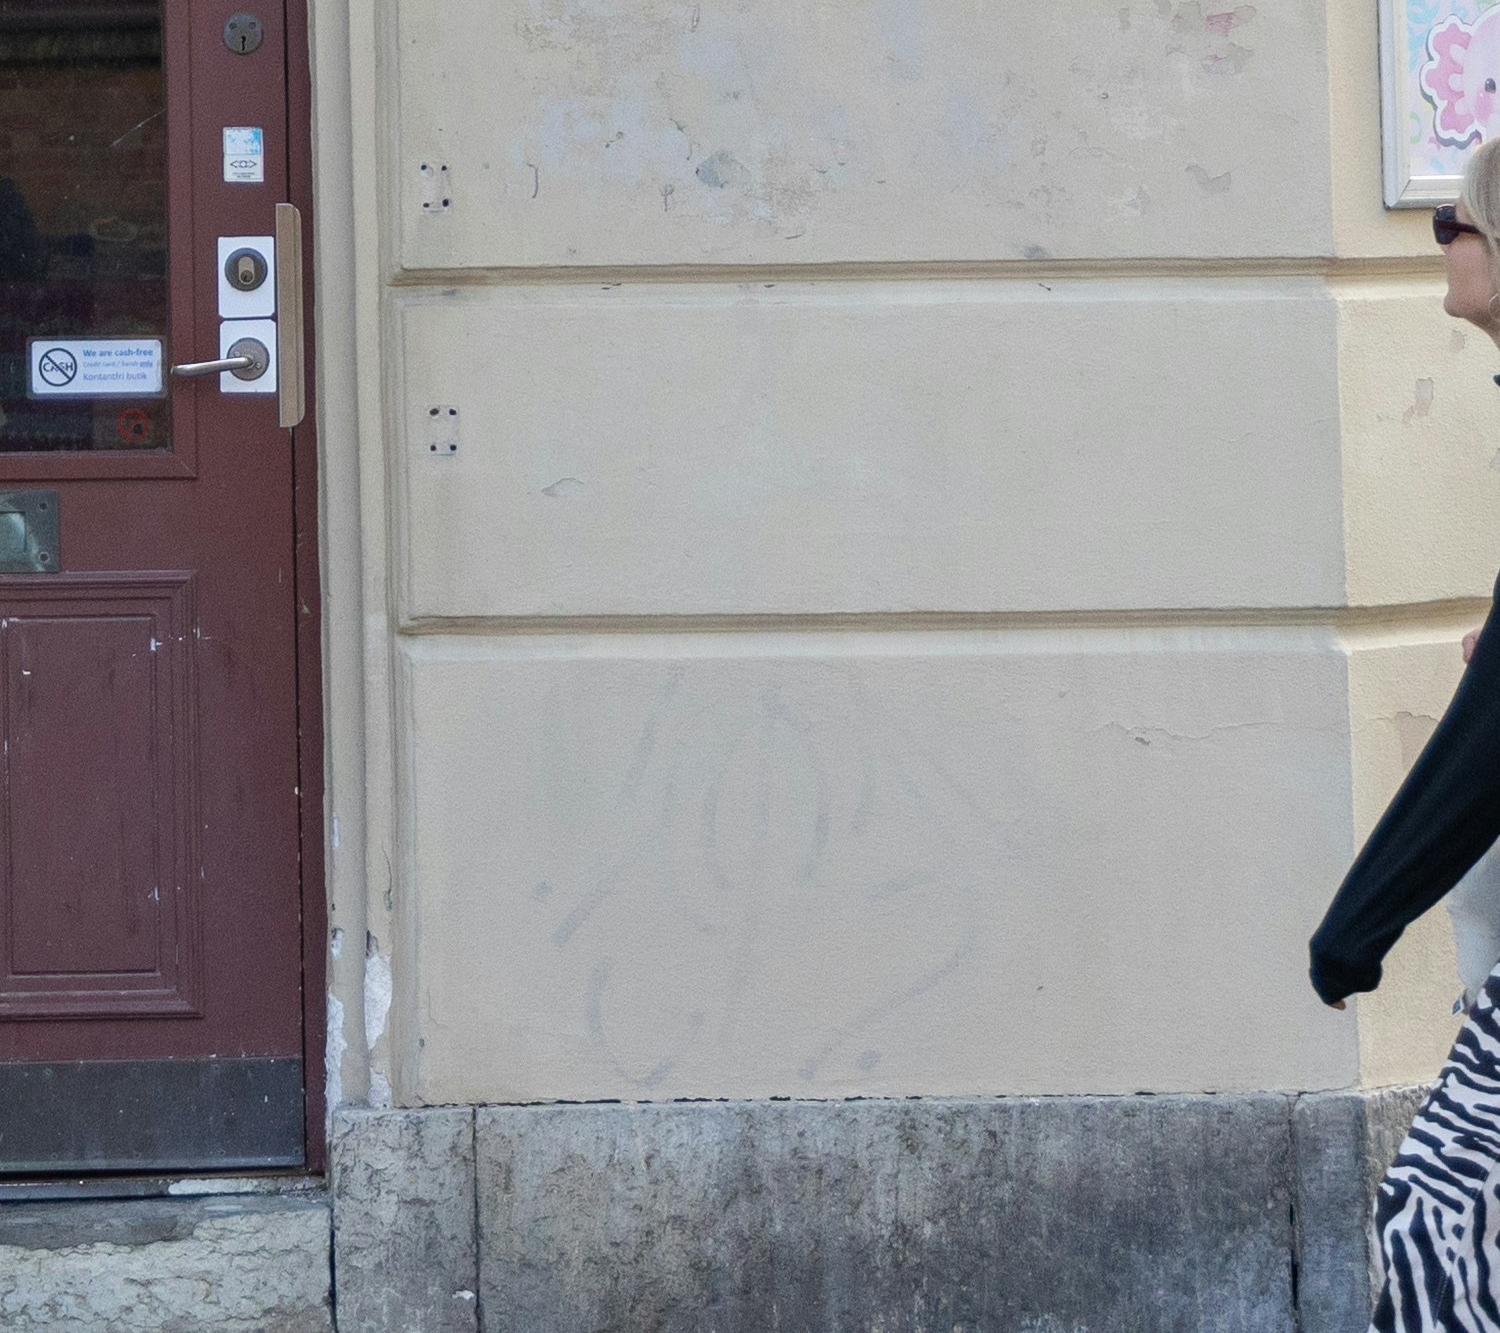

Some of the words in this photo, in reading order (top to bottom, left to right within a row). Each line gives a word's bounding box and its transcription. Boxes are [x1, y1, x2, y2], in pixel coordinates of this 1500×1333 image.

[114, 348, 153, 356] cash-free
[42, 362, 74, 373] CASH
[83, 372, 124, 381] Kontantfri
[127, 372, 147, 380] butik
